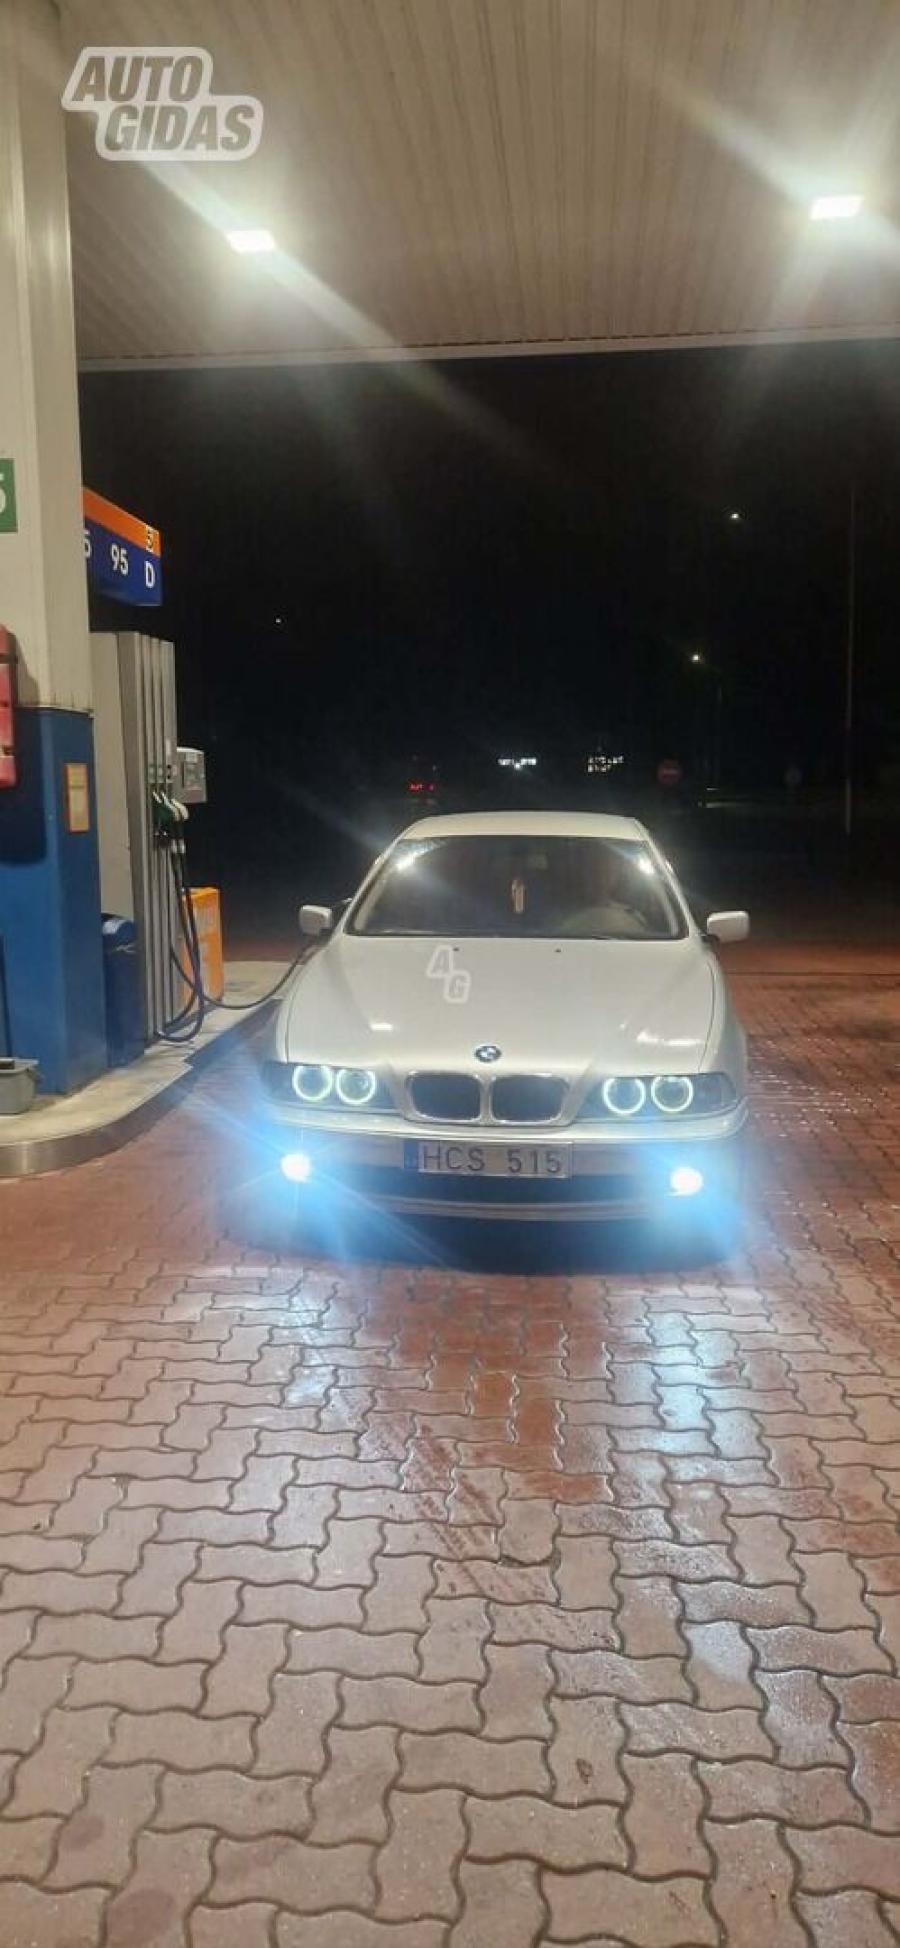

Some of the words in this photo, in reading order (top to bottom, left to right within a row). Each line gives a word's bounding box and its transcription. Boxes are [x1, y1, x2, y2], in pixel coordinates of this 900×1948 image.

[111, 543, 129, 576] 95
[144, 560, 156, 588] D
[422, 1145, 485, 1172] HCS
[508, 1148, 562, 1174] 515
